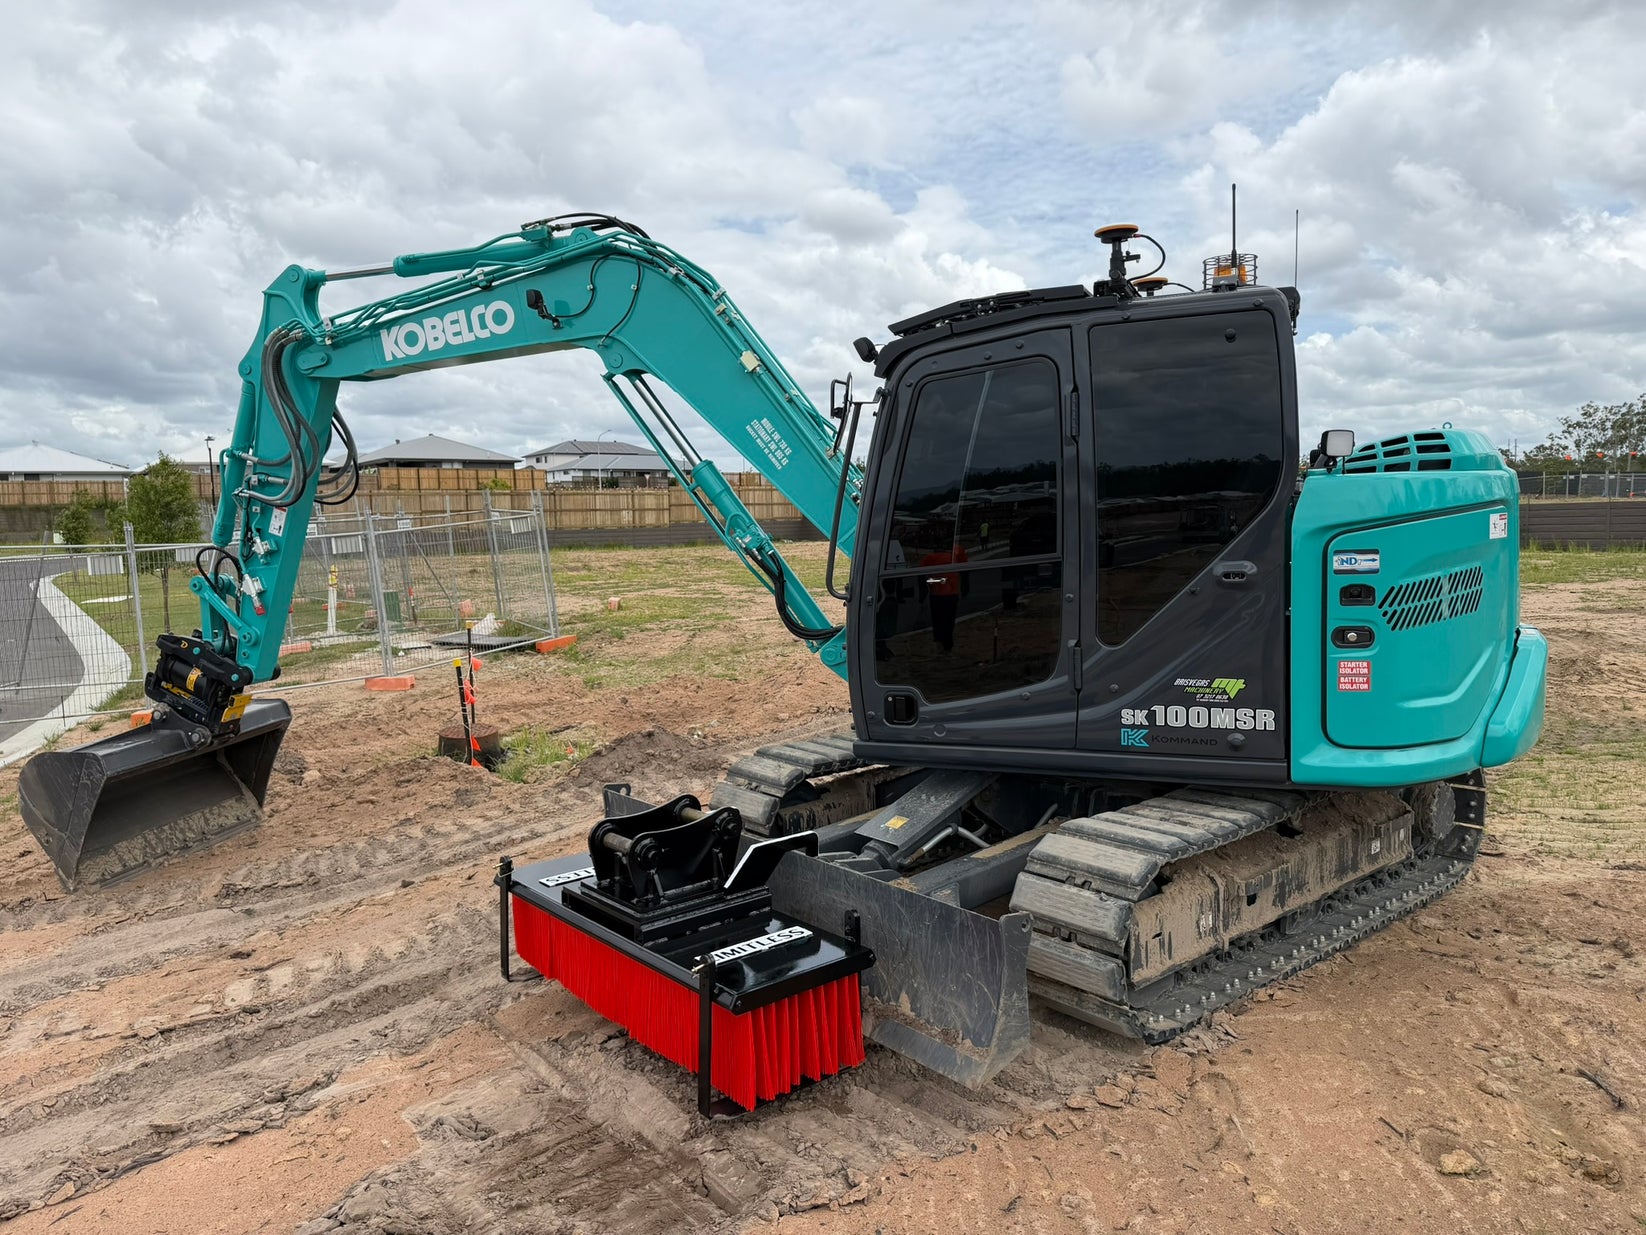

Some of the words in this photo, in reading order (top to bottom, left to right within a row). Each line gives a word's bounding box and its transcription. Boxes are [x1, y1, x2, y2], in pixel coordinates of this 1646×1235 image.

[380, 300, 515, 362] KOBELCO
[1174, 678, 1210, 687] BRISVEGAS
[1183, 686, 1224, 694] MACHINERY
[1152, 734, 1218, 746] KOMMAND
[712, 928, 805, 960] IMITLESS
